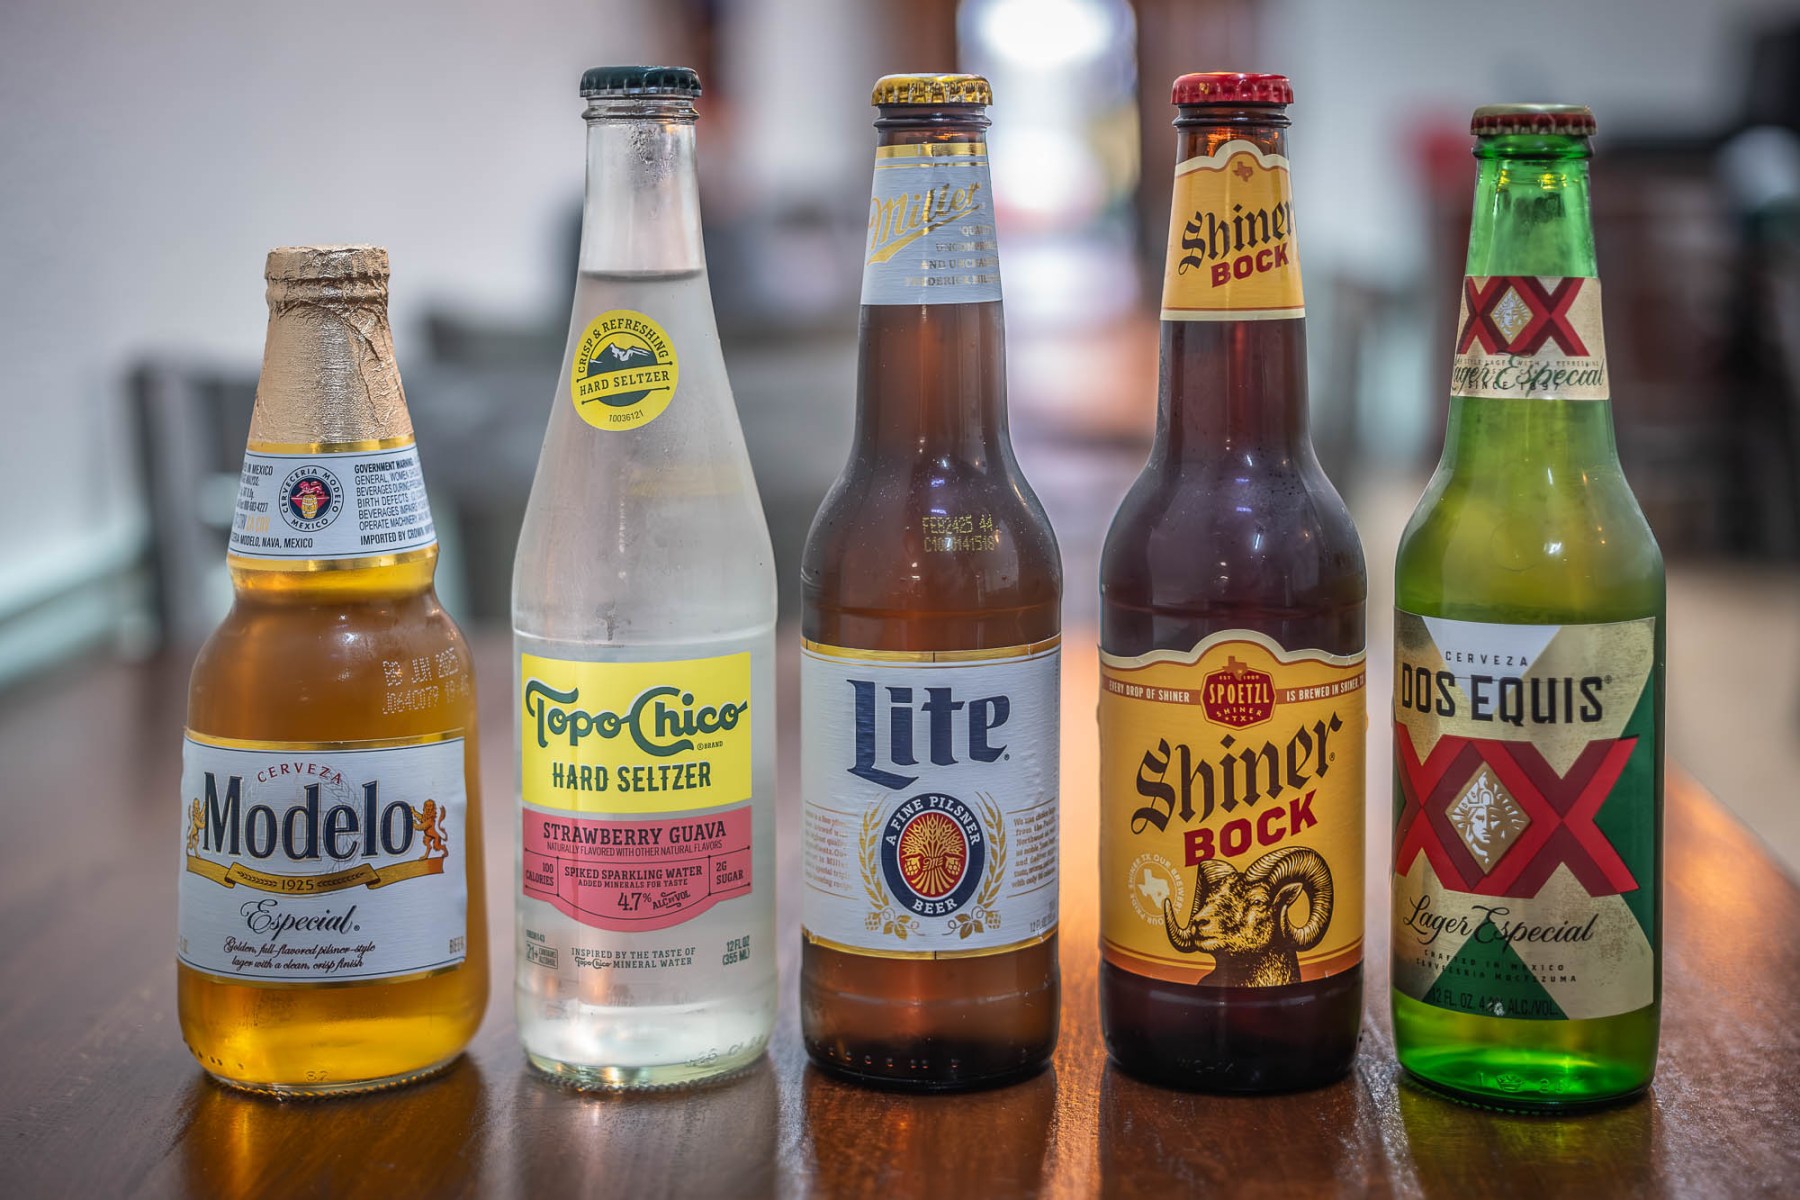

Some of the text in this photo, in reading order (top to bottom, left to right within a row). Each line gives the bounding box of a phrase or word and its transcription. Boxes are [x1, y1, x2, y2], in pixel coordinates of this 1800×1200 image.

[868, 182, 981, 251] Miller
[1211, 243, 1289, 288] BOCK
[578, 318, 669, 374] CRISP & REFRESHING
[580, 370, 670, 396] HARD SELTZER
[608, 409, 644, 422] 10036121
[252, 465, 273, 476] MEXICO
[354, 461, 395, 474] GOVERNMENT
[281, 468, 318, 514] CERVECERIA
[322, 473, 339, 513] MODELO
[356, 484, 392, 497] BEVERAGES
[357, 497, 380, 509] BIRTH
[359, 506, 400, 520] BEVERAGES
[291, 518, 329, 530] MEXICO
[359, 518, 390, 531] OPERATE
[262, 537, 282, 549] NAVA,
[284, 538, 313, 549] MEXICO
[361, 532, 397, 546] IMPORTED
[398, 530, 406, 541] BY
[1445, 651, 1528, 666] CERVEZA
[1126, 685, 1144, 698] DROP
[1146, 688, 1156, 700] OF
[1158, 689, 1190, 703] SHINER
[1209, 683, 1270, 704] SPOETZL
[1286, 690, 1296, 702] IS
[1298, 685, 1330, 700] BREWED
[1332, 682, 1339, 695] IN
[1402, 662, 1603, 727] DOS EQUIS
[526, 677, 624, 748] Topo
[627, 685, 748, 757] Chico
[1216, 707, 1262, 717] SHINER
[847, 679, 1010, 790] Lite
[257, 763, 342, 784] CERVEZA
[552, 761, 711, 792] HARD SELTZER
[1130, 711, 1343, 835] Shiner
[203, 771, 415, 861] Modelo
[886, 796, 981, 846] A FINE PILSNER
[543, 821, 727, 846] STRAWBERRY GUAVA
[1016, 827, 1032, 836] from
[1184, 788, 1319, 867] BOCK
[546, 840, 723, 857] NATURALLY FLAVORED WITH OTHER NATURAL FLAVORS
[542, 862, 554, 874] 100
[564, 865, 703, 881] SPIKED SPARKLING WATER
[716, 862, 727, 872] 2G
[281, 879, 314, 891] 1925
[525, 869, 555, 887] CALORIES
[578, 878, 688, 889] ADDED MINERALS FOR TASTE
[716, 869, 744, 885] SUGAR
[617, 892, 652, 911] 4.7%
[913, 897, 958, 915] BEER
[240, 899, 352, 941] Especial
[1402, 895, 1599, 953] Lager Especial
[223, 936, 376, 959] Golden, full-flavored pilsner-style
[571, 947, 696, 959] INSPIRED BY THE TASTE OF
[232, 955, 253, 972] lager
[254, 959, 272, 969] with
[283, 959, 310, 970] clean,
[313, 958, 335, 973] crisp
[331, 957, 363, 973] finish
[613, 960, 657, 969] MINERAL
[660, 957, 692, 968] WATER
[1495, 973, 1577, 983] MOCTEZUMA
